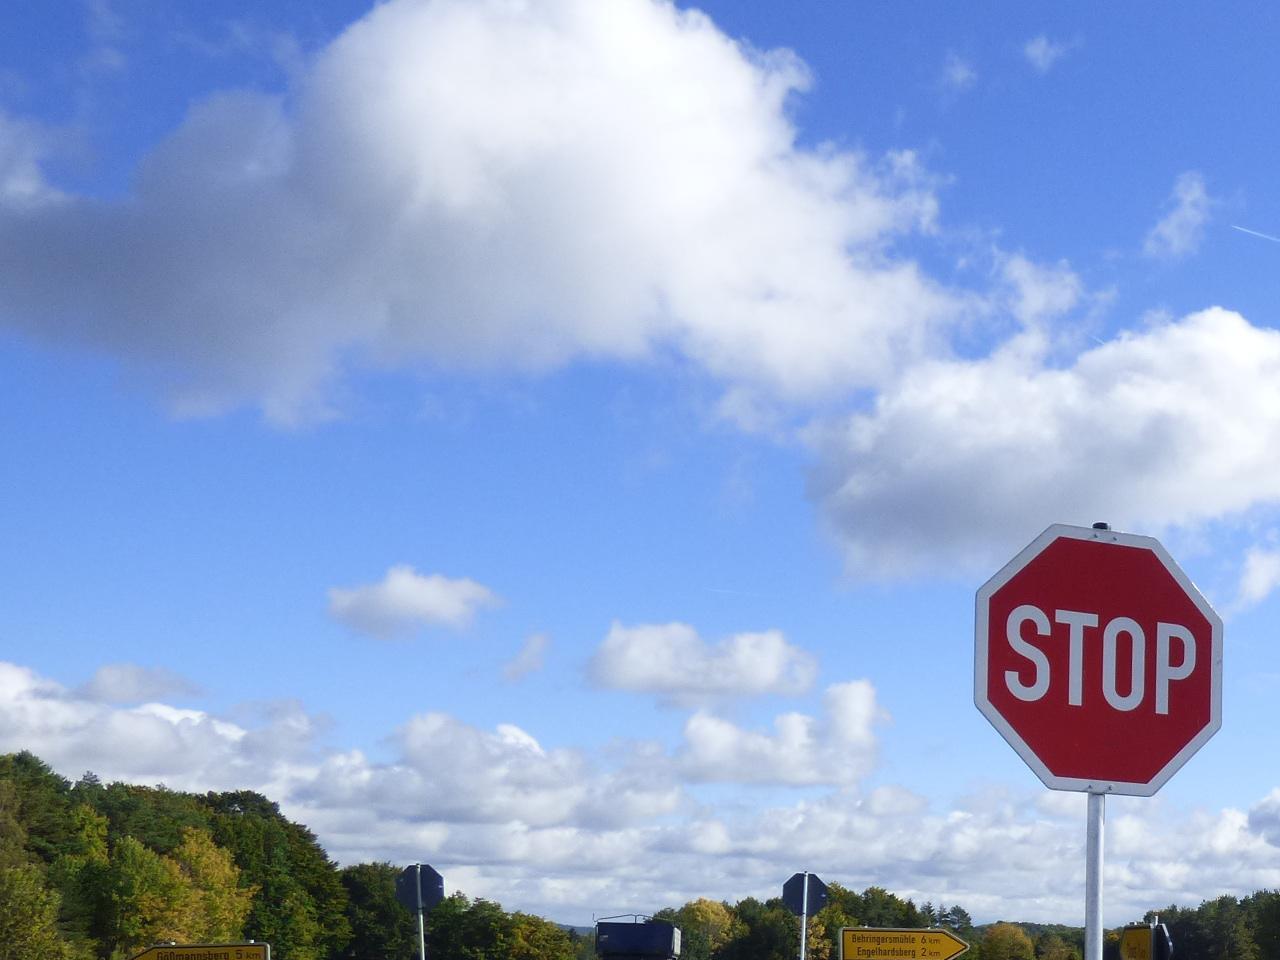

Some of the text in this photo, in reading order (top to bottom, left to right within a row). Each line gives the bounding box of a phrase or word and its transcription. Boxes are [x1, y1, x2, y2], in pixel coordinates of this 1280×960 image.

[1004, 604, 1197, 715] STOP
[852, 933, 941, 945] Behringersmühle 6 km
[245, 951, 262, 960] km
[857, 946, 941, 958] Engelhardsberg 2 km
